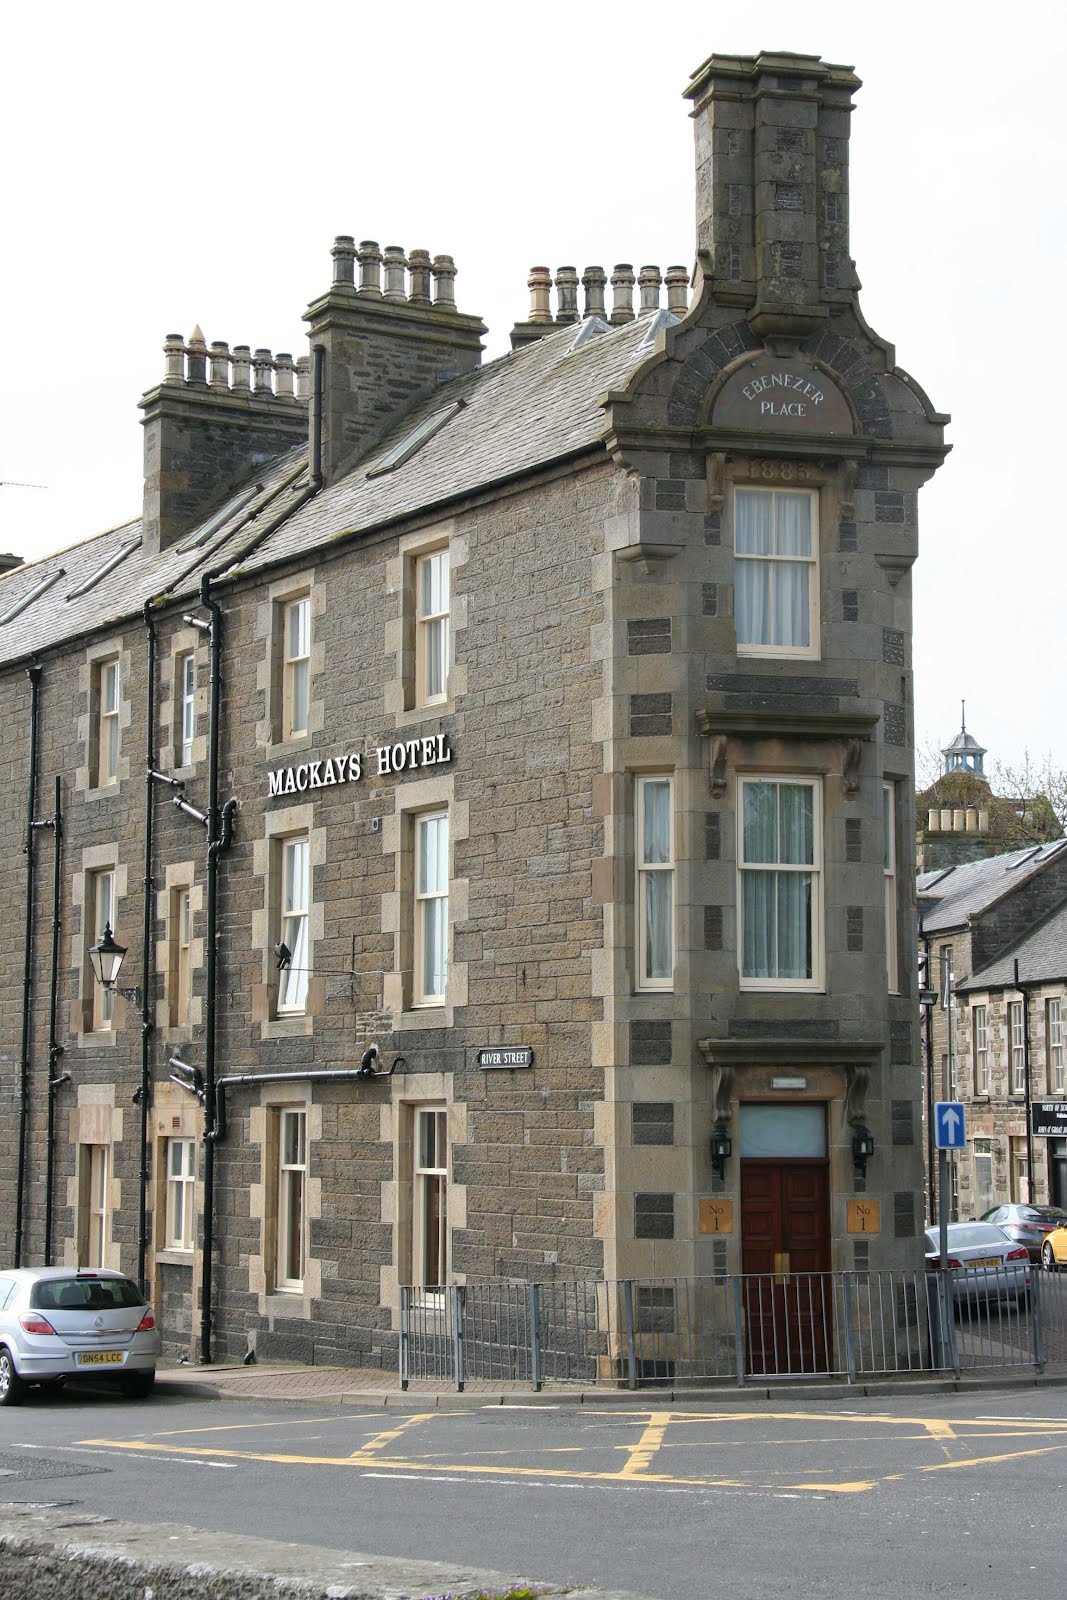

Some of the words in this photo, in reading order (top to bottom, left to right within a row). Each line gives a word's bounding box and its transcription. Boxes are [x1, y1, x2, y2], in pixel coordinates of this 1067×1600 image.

[742, 373, 824, 405] EBENEZER
[761, 401, 807, 417] PLACE
[267, 753, 361, 797] MACKAYS
[376, 734, 451, 775] HOTEL
[481, 1053, 502, 1065] RIVER
[504, 1051, 528, 1064] STREET
[709, 1205, 724, 1215] No
[856, 1205, 871, 1215] No
[714, 1217, 720, 1231] 1
[860, 1217, 867, 1231] 1
[82, 1354, 104, 1363] DN54
[106, 1353, 122, 1362] LCC
